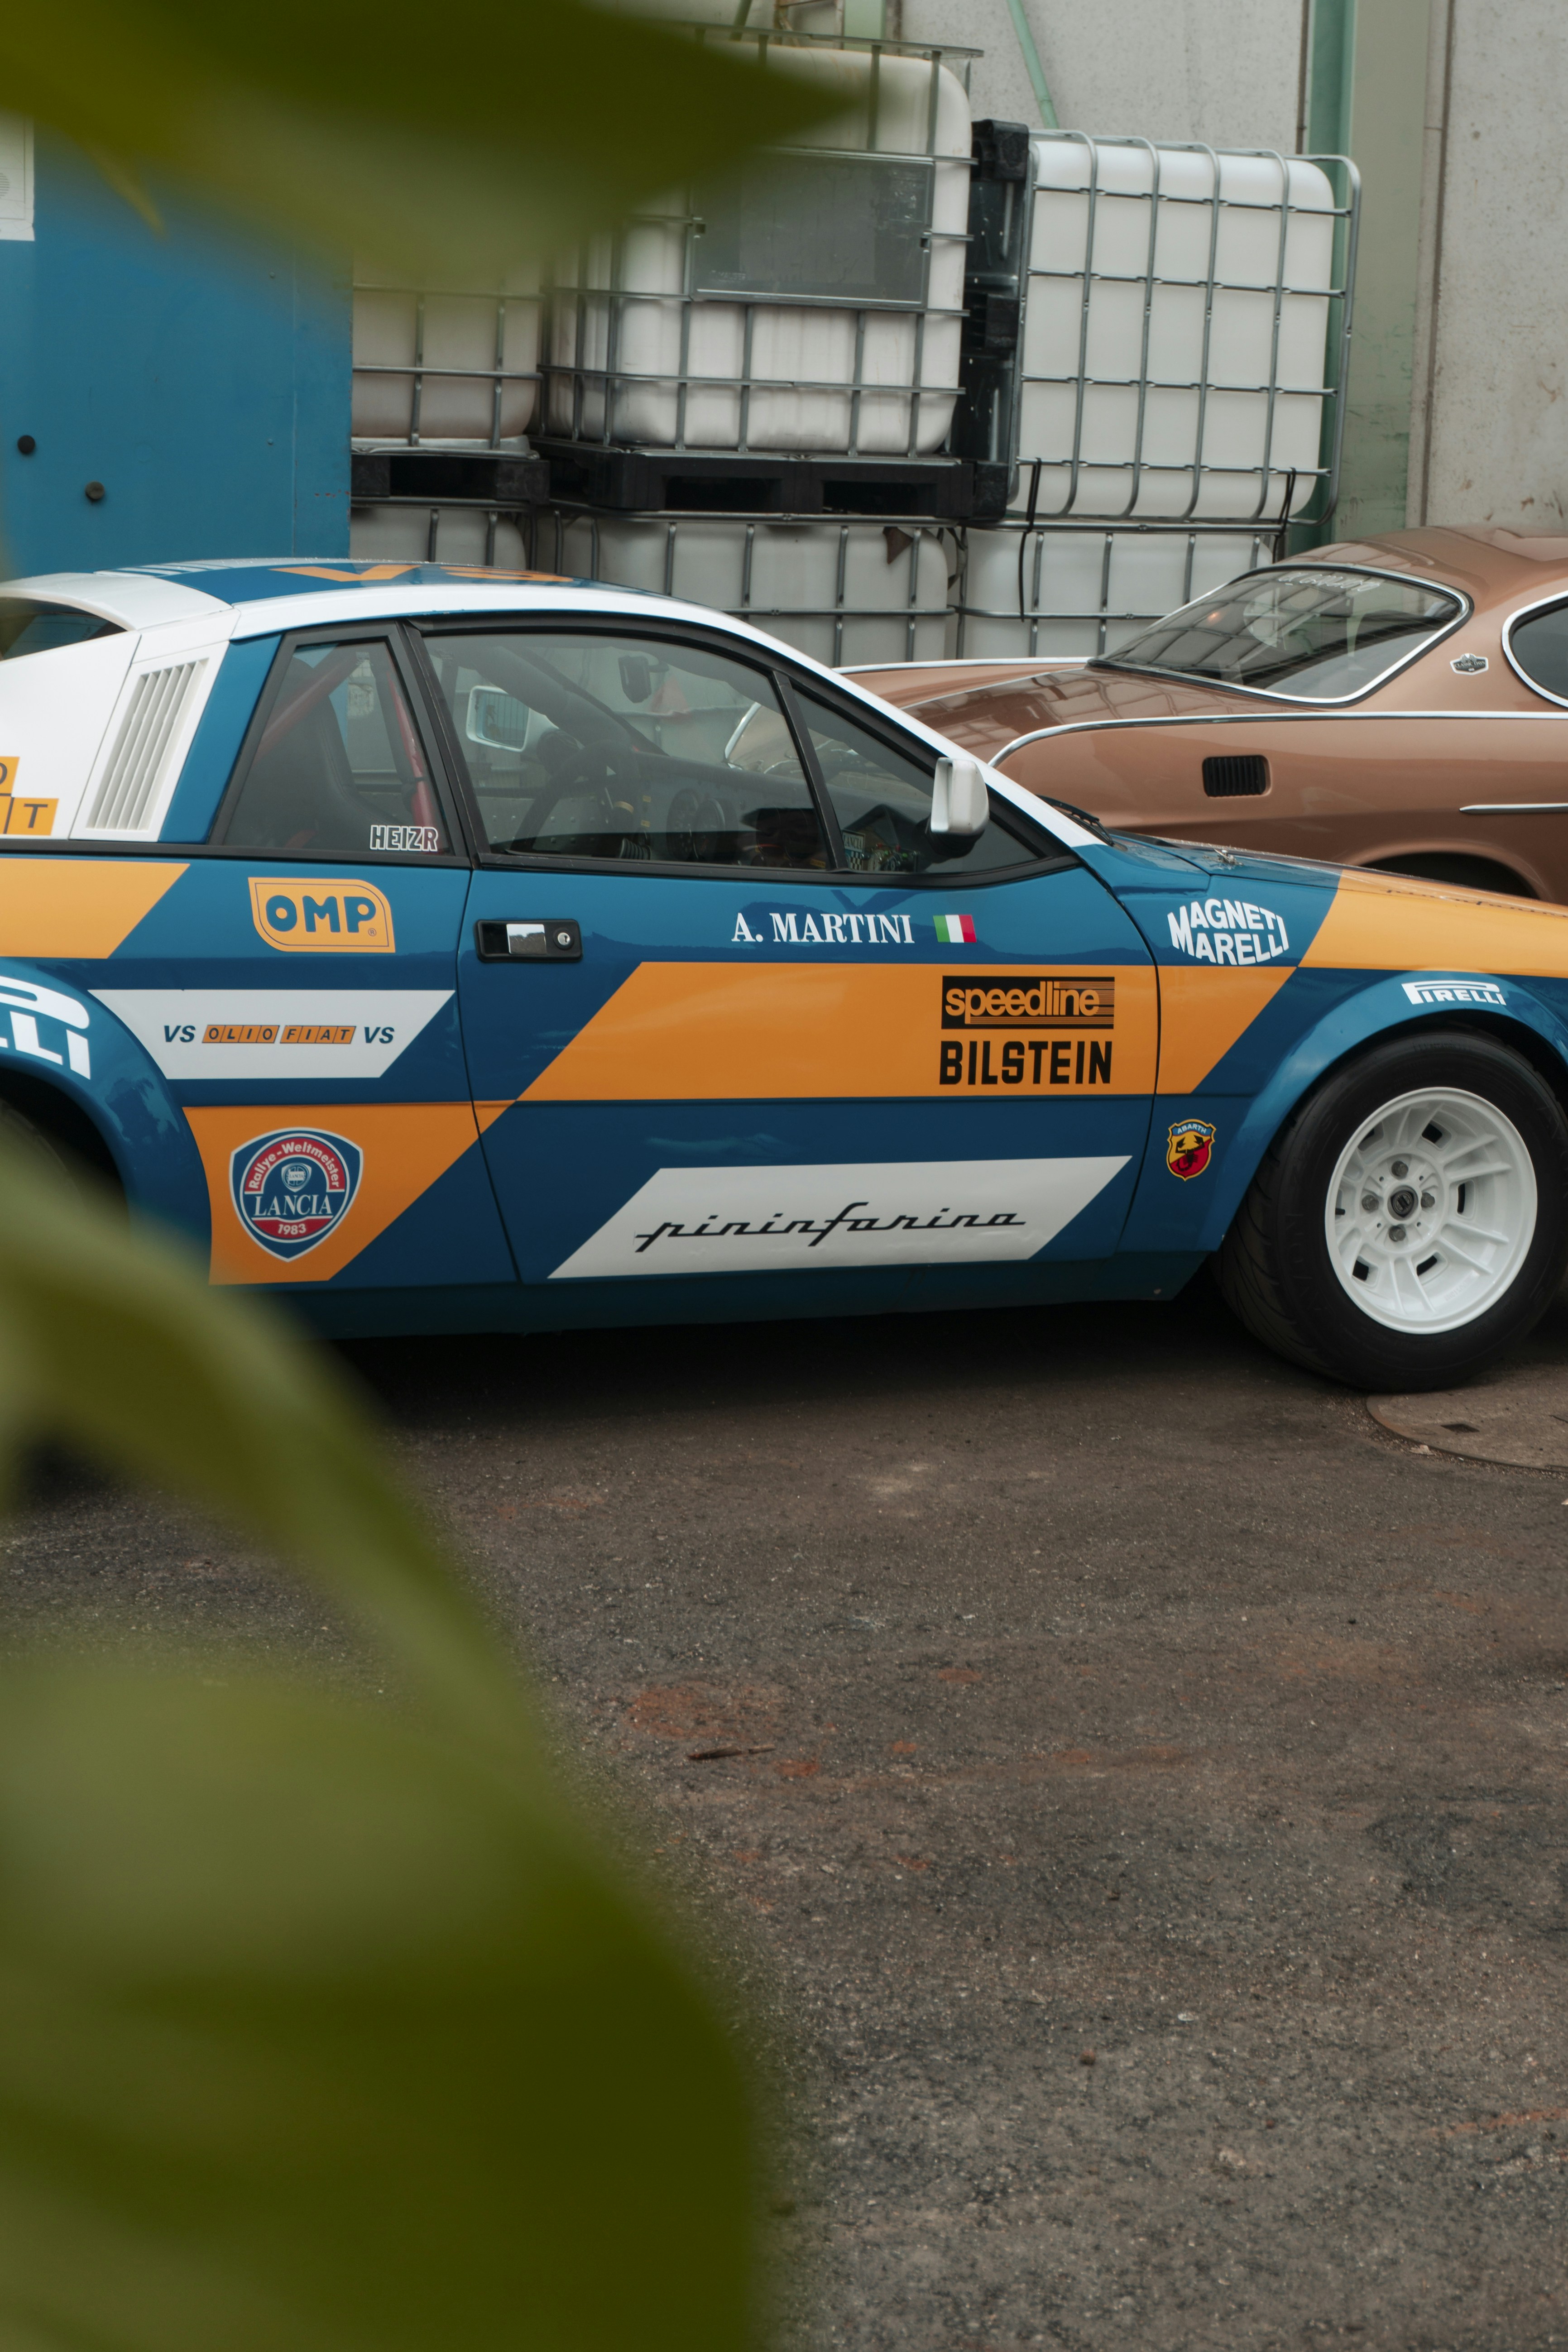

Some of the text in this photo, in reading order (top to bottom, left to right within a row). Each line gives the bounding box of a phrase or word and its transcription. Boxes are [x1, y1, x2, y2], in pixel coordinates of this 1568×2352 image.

[370, 825, 439, 852] HEIZR
[266, 895, 376, 933] OMP
[731, 912, 915, 944] A. MARTINI
[1167, 899, 1289, 957] MAGNETI
[1167, 905, 1289, 965] MARELLI
[945, 981, 1099, 1024] speedline
[1401, 980, 1507, 1006] PIRELLI
[163, 1025, 395, 1044] VS OLIO FIAT VS
[939, 1040, 1112, 1085] BILSTEIN
[1177, 1123, 1207, 1134] ABARTH
[254, 1195, 332, 1216] LANCIA
[278, 1224, 306, 1235] 1983
[635, 1202, 1026, 1253] pininfarina
